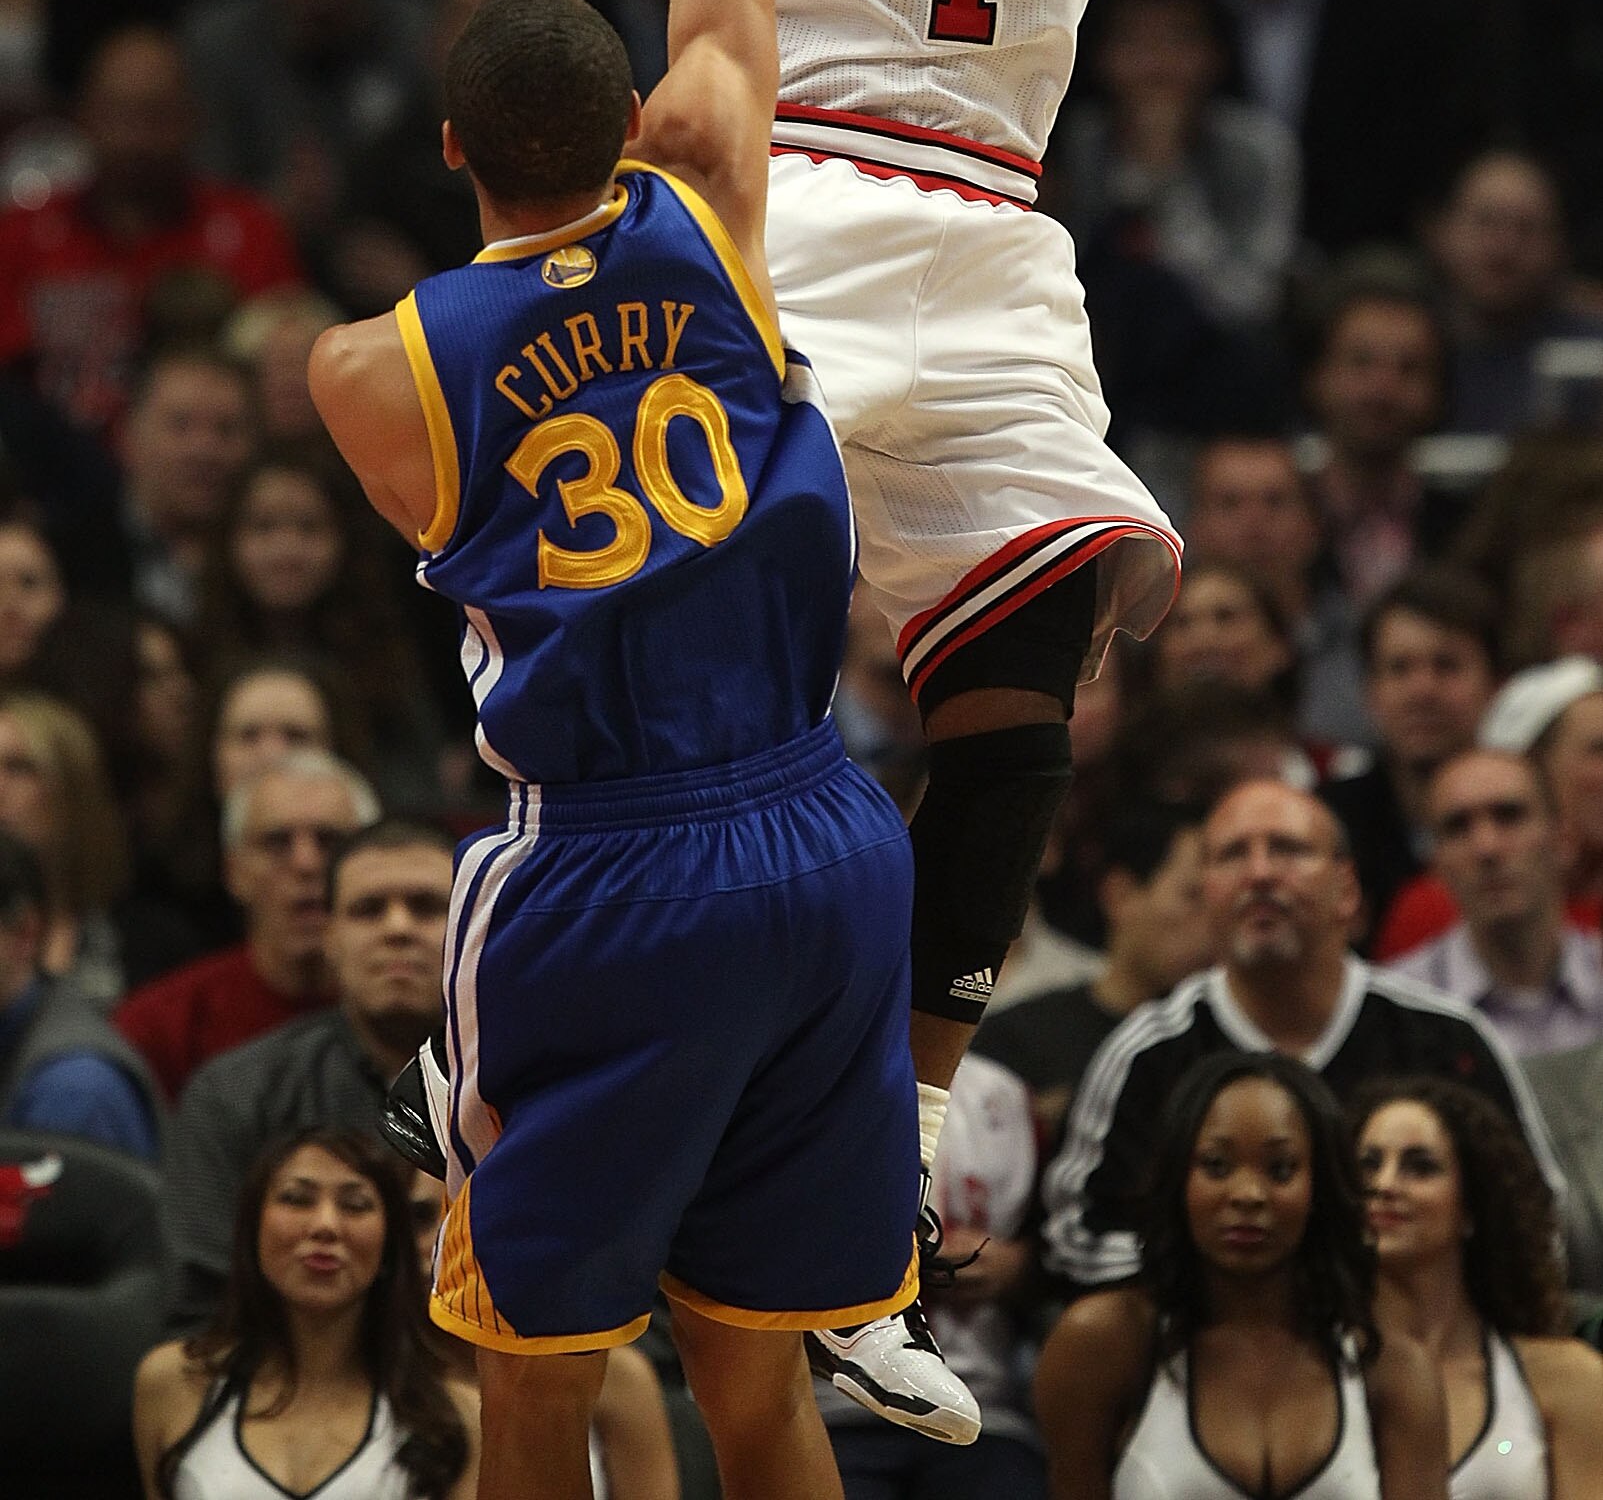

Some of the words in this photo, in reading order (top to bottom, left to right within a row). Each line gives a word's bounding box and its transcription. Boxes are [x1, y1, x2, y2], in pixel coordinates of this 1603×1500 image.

[495, 301, 695, 420] CURRY
[504, 373, 749, 591] 30
[953, 979, 994, 994] adida
